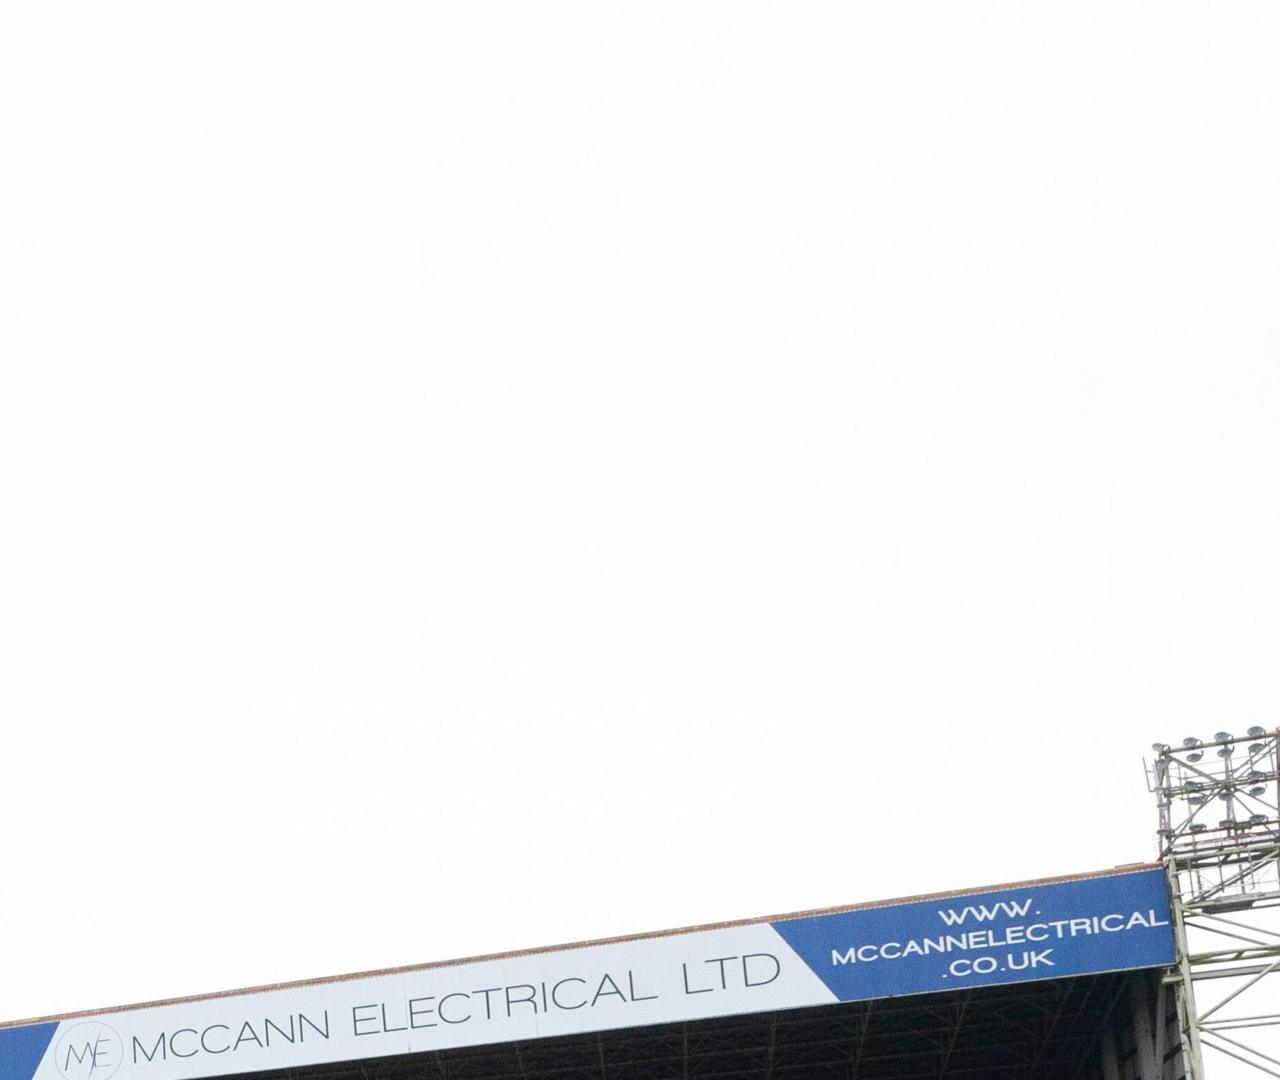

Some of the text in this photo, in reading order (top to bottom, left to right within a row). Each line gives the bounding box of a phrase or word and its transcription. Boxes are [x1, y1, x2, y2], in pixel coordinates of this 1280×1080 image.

[938, 898, 1041, 927] WWW.
[831, 909, 1169, 967] MCCANNELECTRICAL
[941, 948, 1055, 979] .CO.UK
[131, 952, 782, 1065] MCCANN ELECTRICAL LTD
